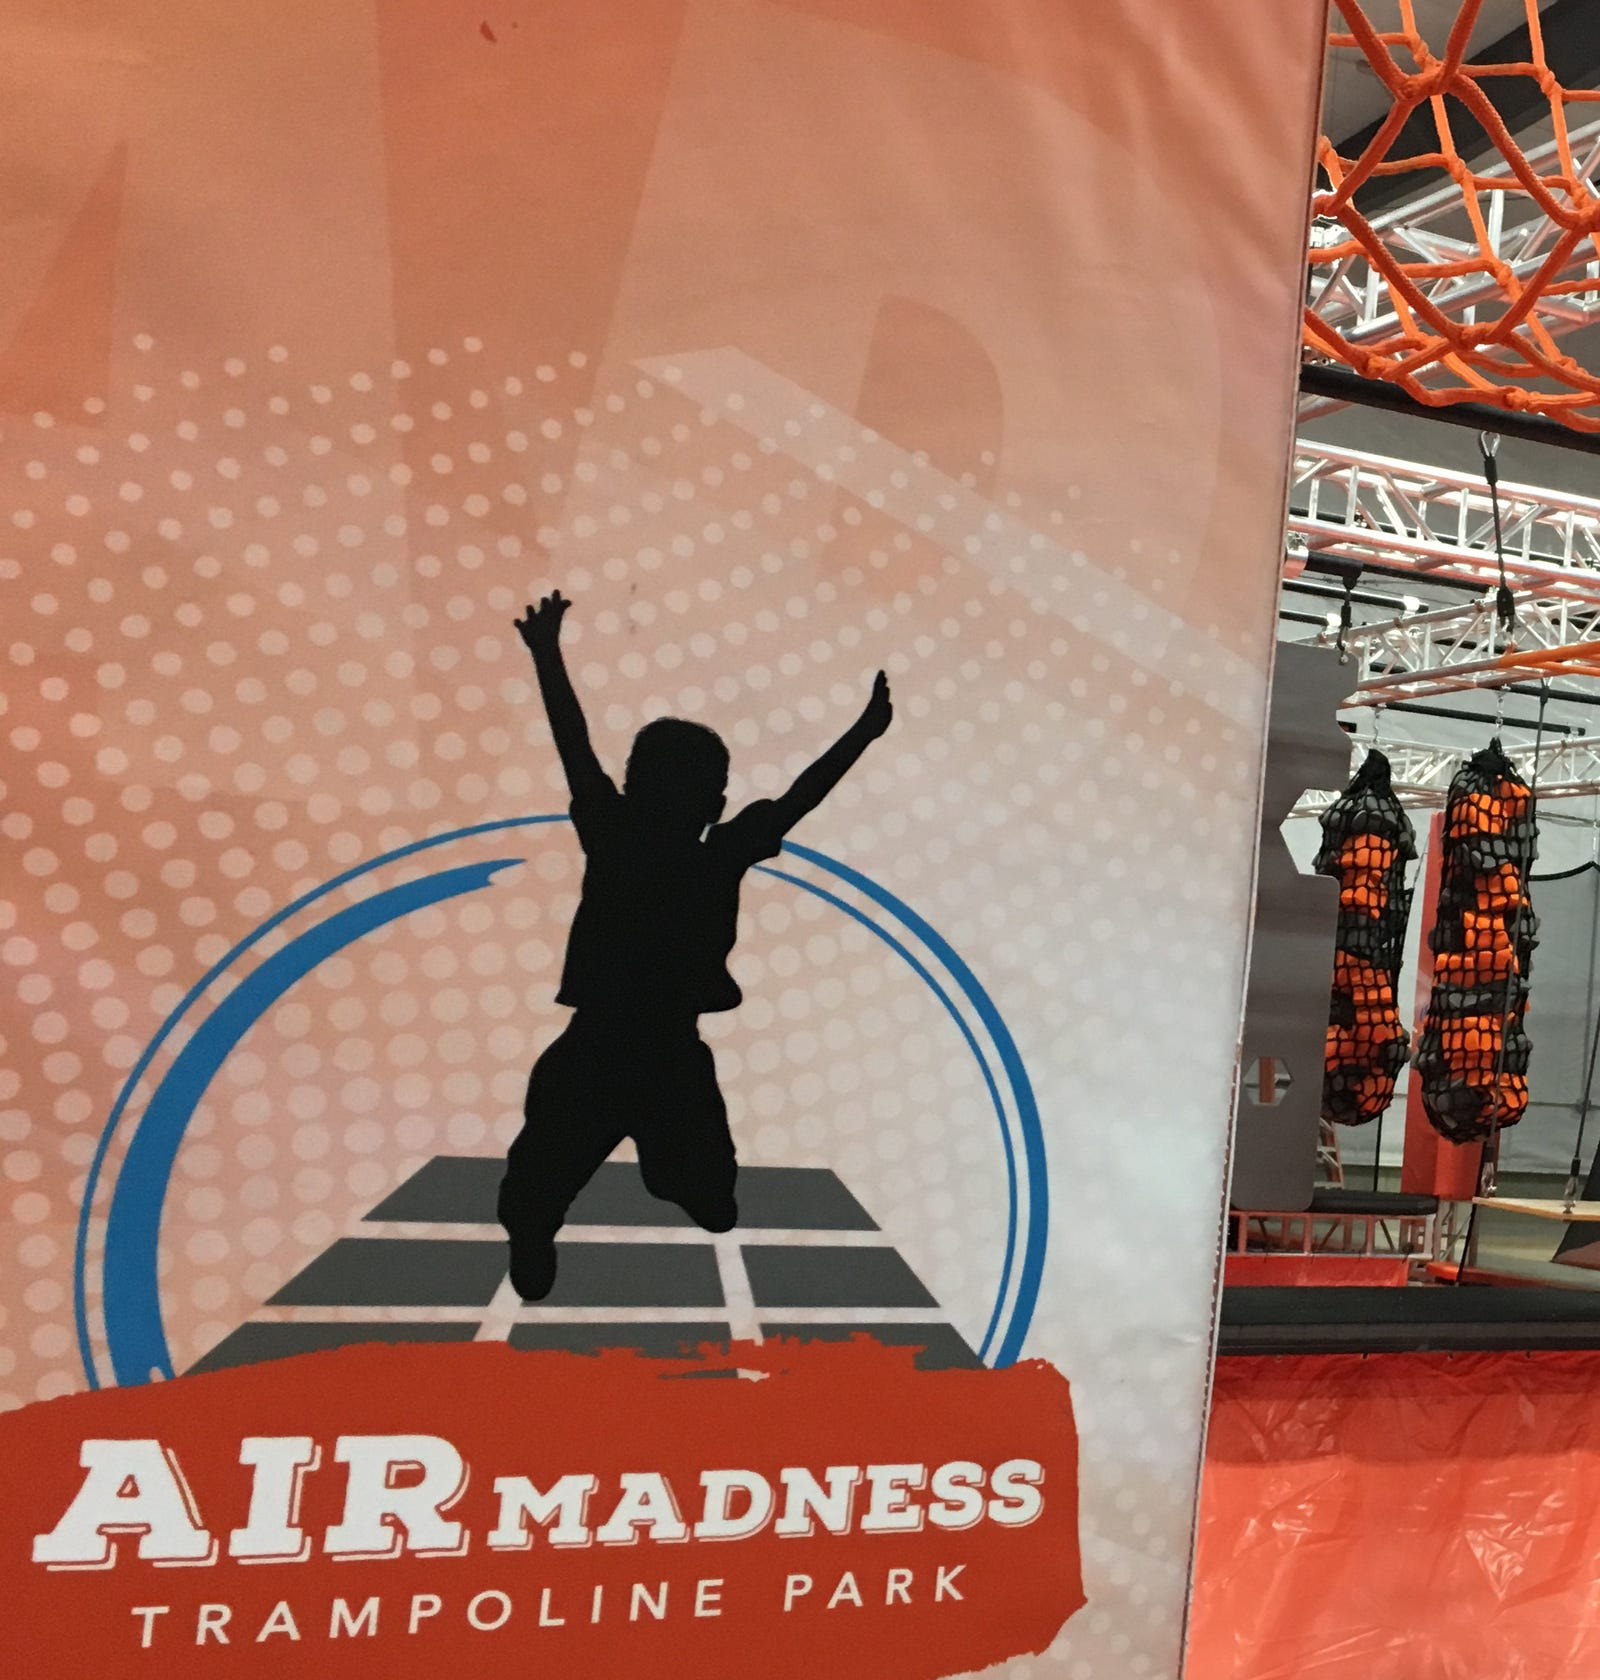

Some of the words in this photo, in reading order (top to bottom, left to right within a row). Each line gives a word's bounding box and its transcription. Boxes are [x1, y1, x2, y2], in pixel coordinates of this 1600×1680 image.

[32, 1435, 470, 1571] AIR
[487, 1459, 1045, 1551] MADNESS
[131, 1579, 723, 1648] TRAMPOLINE
[784, 1565, 965, 1611] PARK
